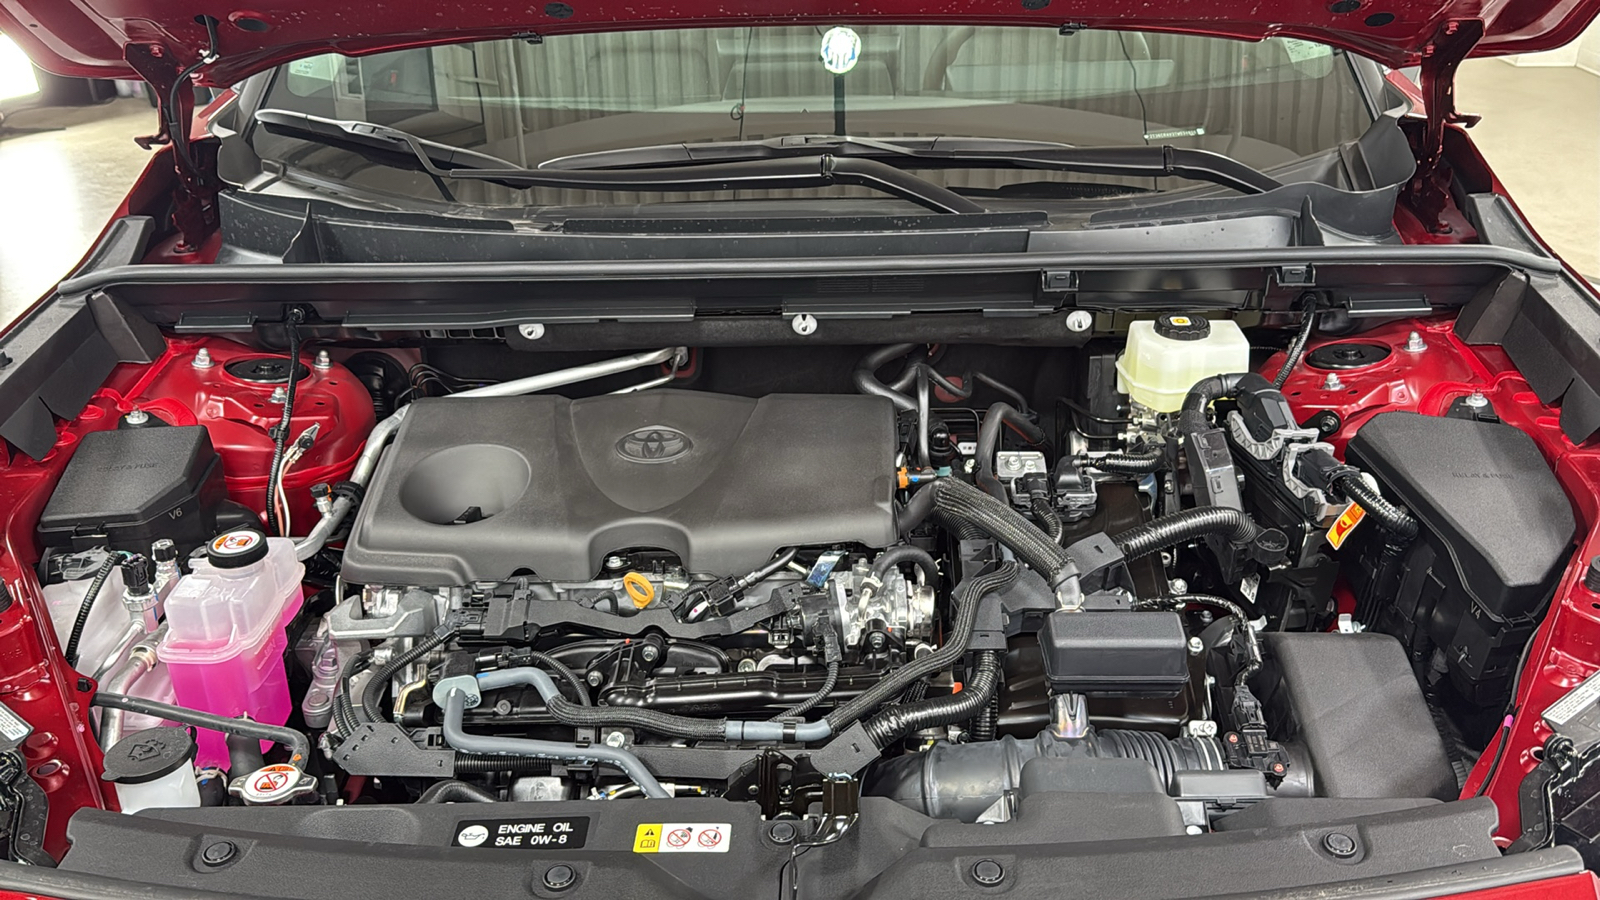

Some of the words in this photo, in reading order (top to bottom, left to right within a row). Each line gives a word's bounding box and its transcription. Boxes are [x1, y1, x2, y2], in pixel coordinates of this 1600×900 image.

[168, 507, 183, 520] V6
[1470, 600, 1481, 620] V4
[498, 823, 546, 834] ENGINE
[552, 822, 574, 833] OIL
[495, 835, 523, 846] SAE
[530, 834, 568, 846] 0W-8
